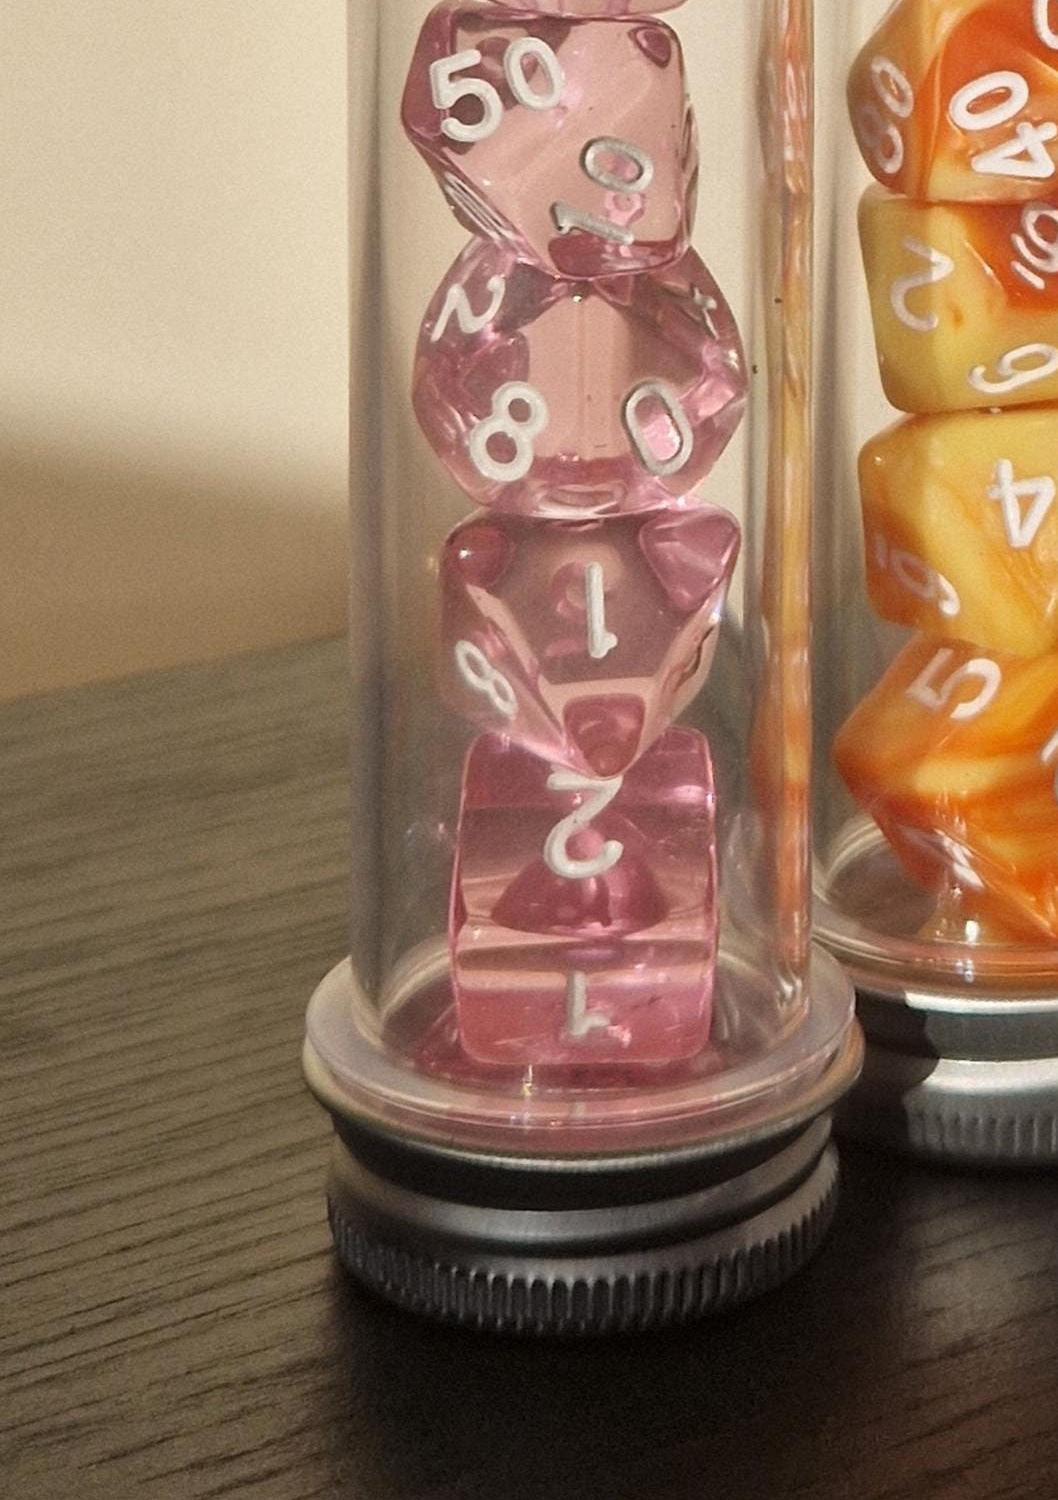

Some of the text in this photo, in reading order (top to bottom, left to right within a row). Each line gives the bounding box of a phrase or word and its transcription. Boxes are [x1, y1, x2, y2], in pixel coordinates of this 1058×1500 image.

[429, 37, 566, 143] 50
[949, 70, 1058, 178] 40
[550, 135, 654, 245] 10
[430, 275, 506, 342] 2
[890, 236, 955, 332] 2
[469, 381, 547, 482] 8
[621, 377, 693, 476] 0
[985, 457, 1056, 548] 4
[586, 562, 618, 659] 1
[455, 640, 518, 719] 8
[905, 647, 1002, 723] 5
[544, 773, 624, 879] 2
